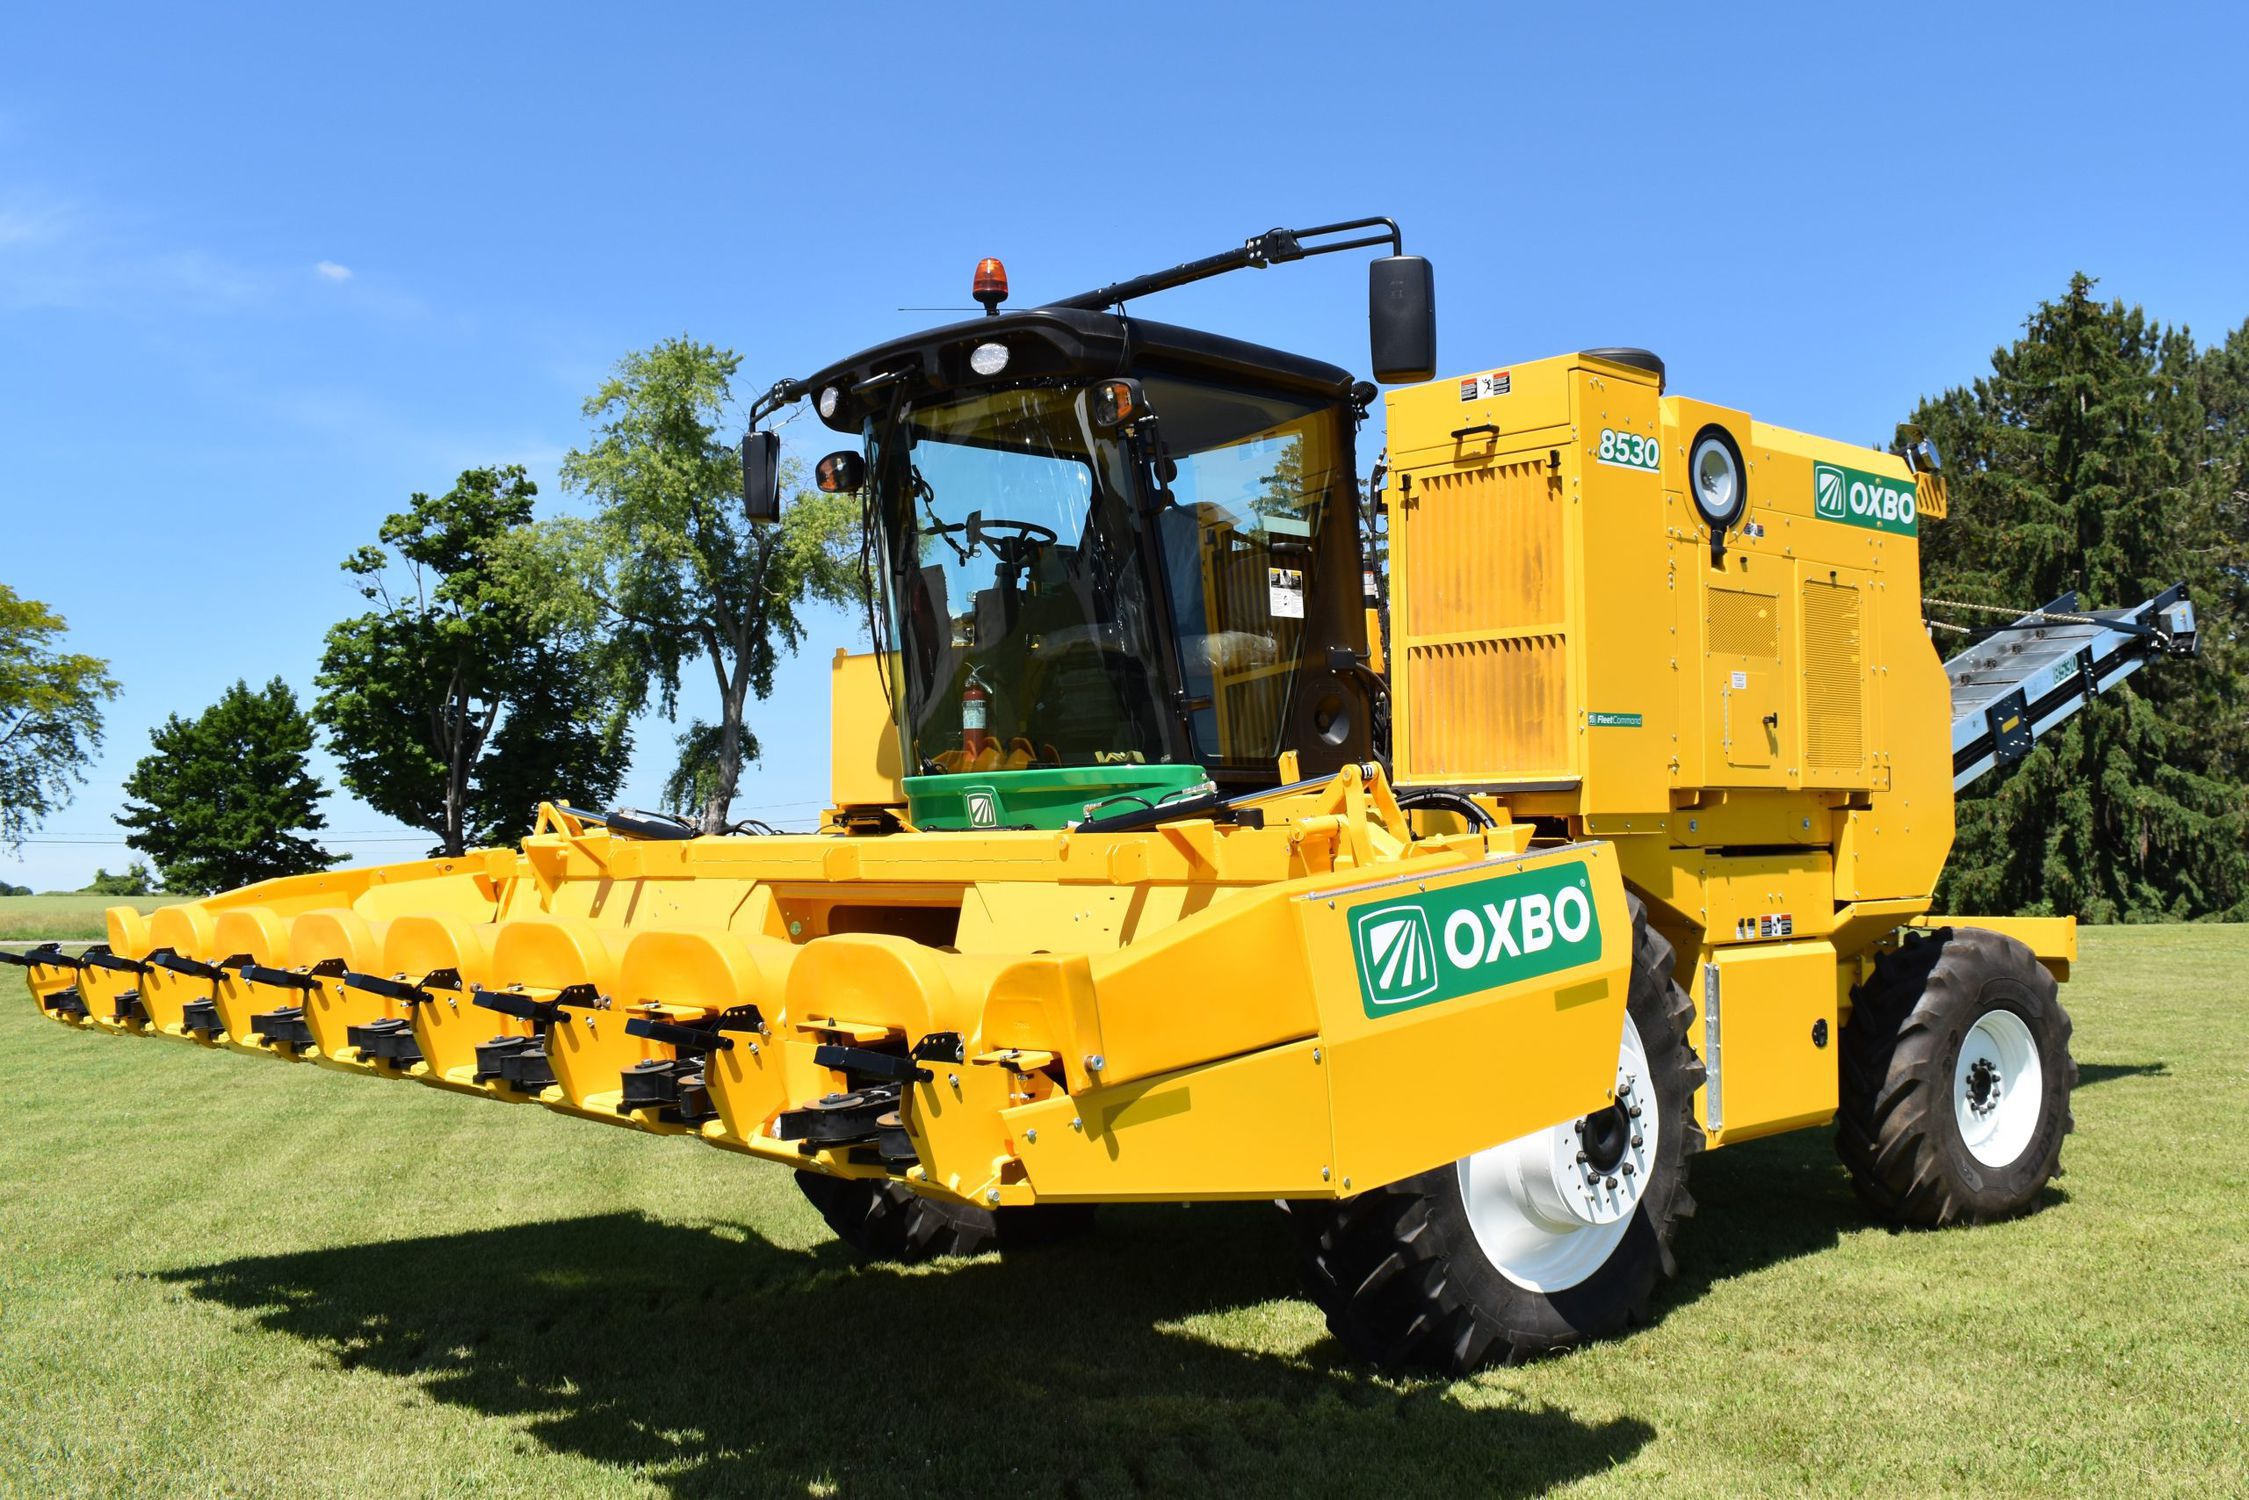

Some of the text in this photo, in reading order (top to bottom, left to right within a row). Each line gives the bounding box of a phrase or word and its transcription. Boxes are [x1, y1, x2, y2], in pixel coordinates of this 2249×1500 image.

[1599, 429, 1660, 468] 8530
[1849, 481, 1916, 525] OXBO
[2054, 655, 2077, 682] 8530
[1443, 885, 1591, 970] OXBO
